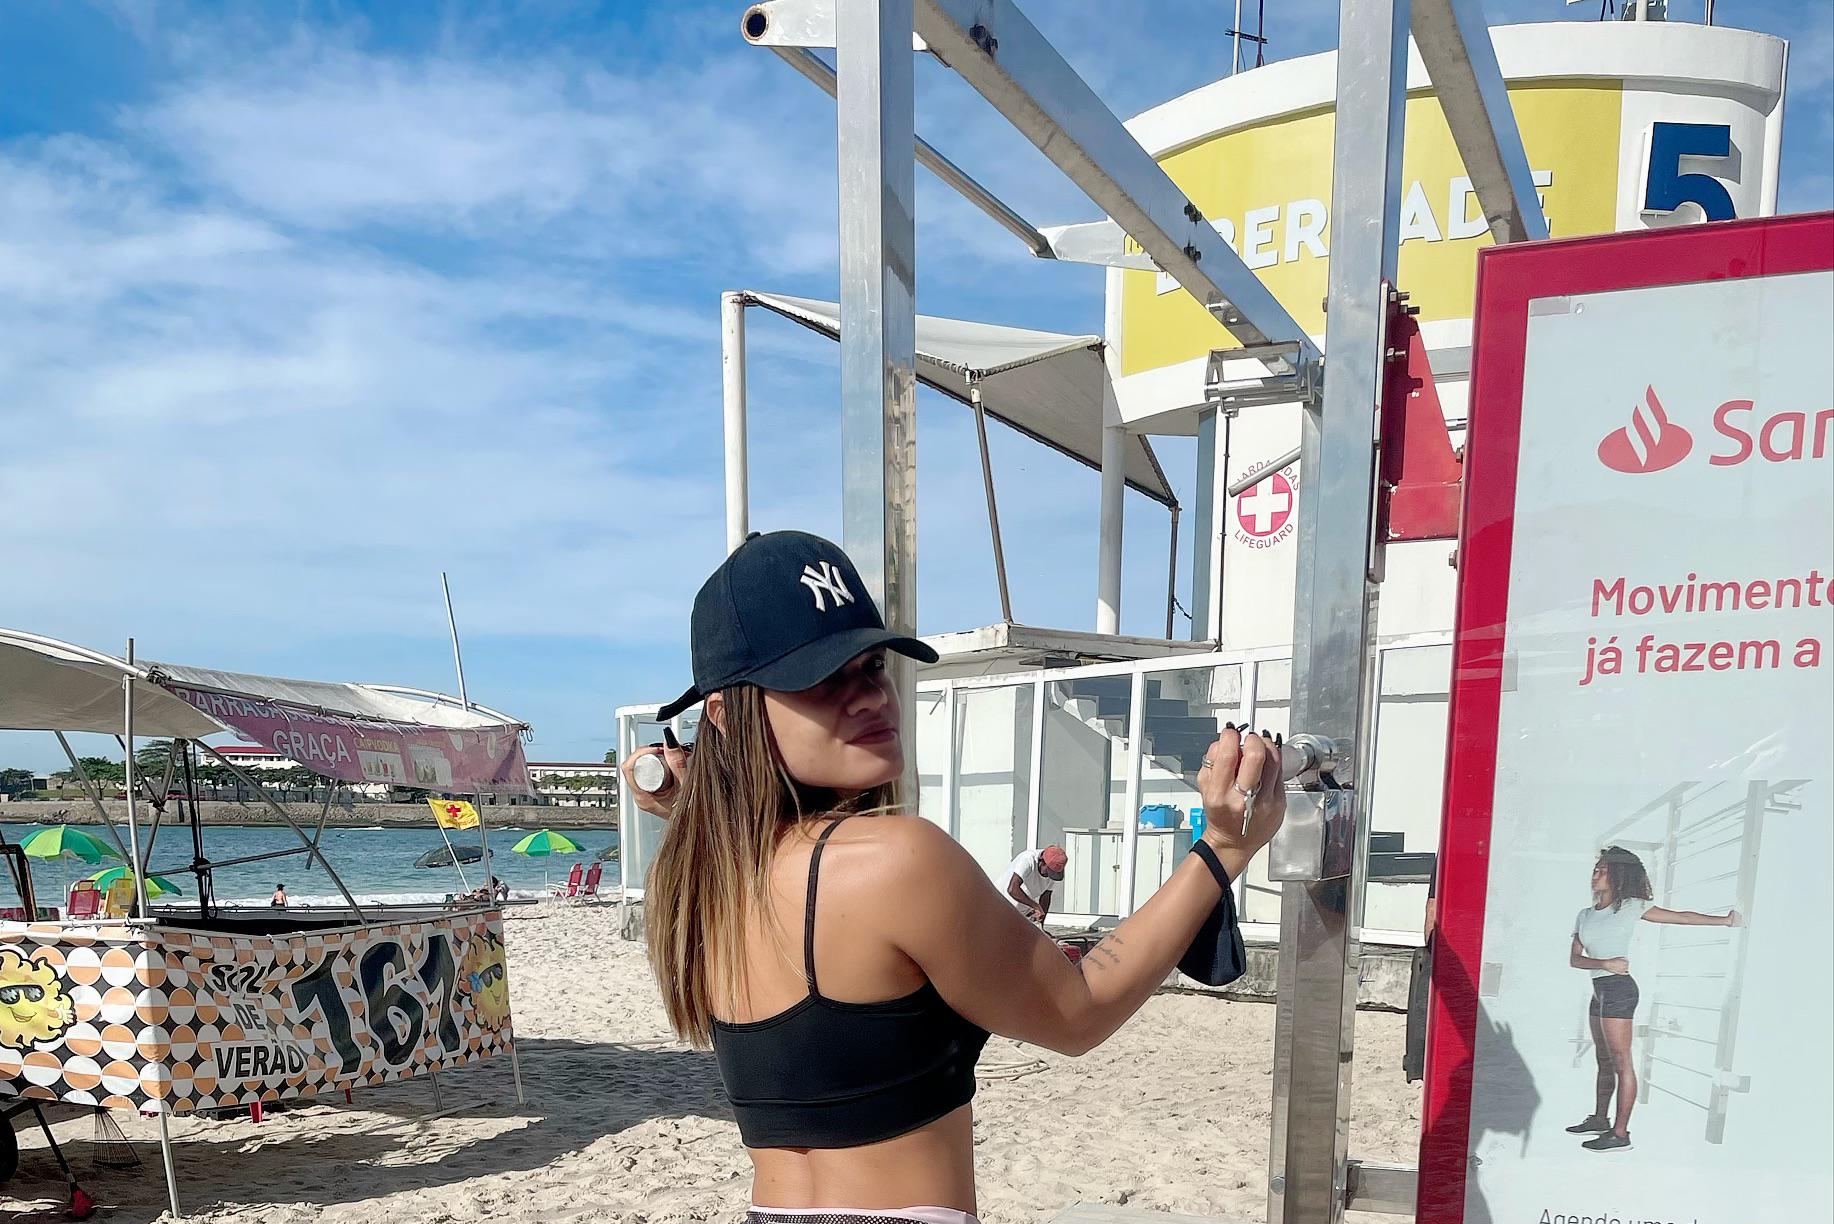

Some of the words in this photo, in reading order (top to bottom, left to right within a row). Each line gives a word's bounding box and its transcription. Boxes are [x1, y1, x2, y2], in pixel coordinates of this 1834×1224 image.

[1645, 122, 1737, 222] 5
[1234, 523, 1294, 549] LIFEGUARD
[799, 560, 855, 613] NY
[1578, 635, 1623, 687] já
[1634, 634, 1781, 675] fazem
[1792, 636, 1822, 669] a
[272, 729, 352, 769] GRAÇA
[234, 1002, 266, 1031] DE
[291, 933, 461, 1076] 161
[214, 1036, 306, 1080] VERÃO
